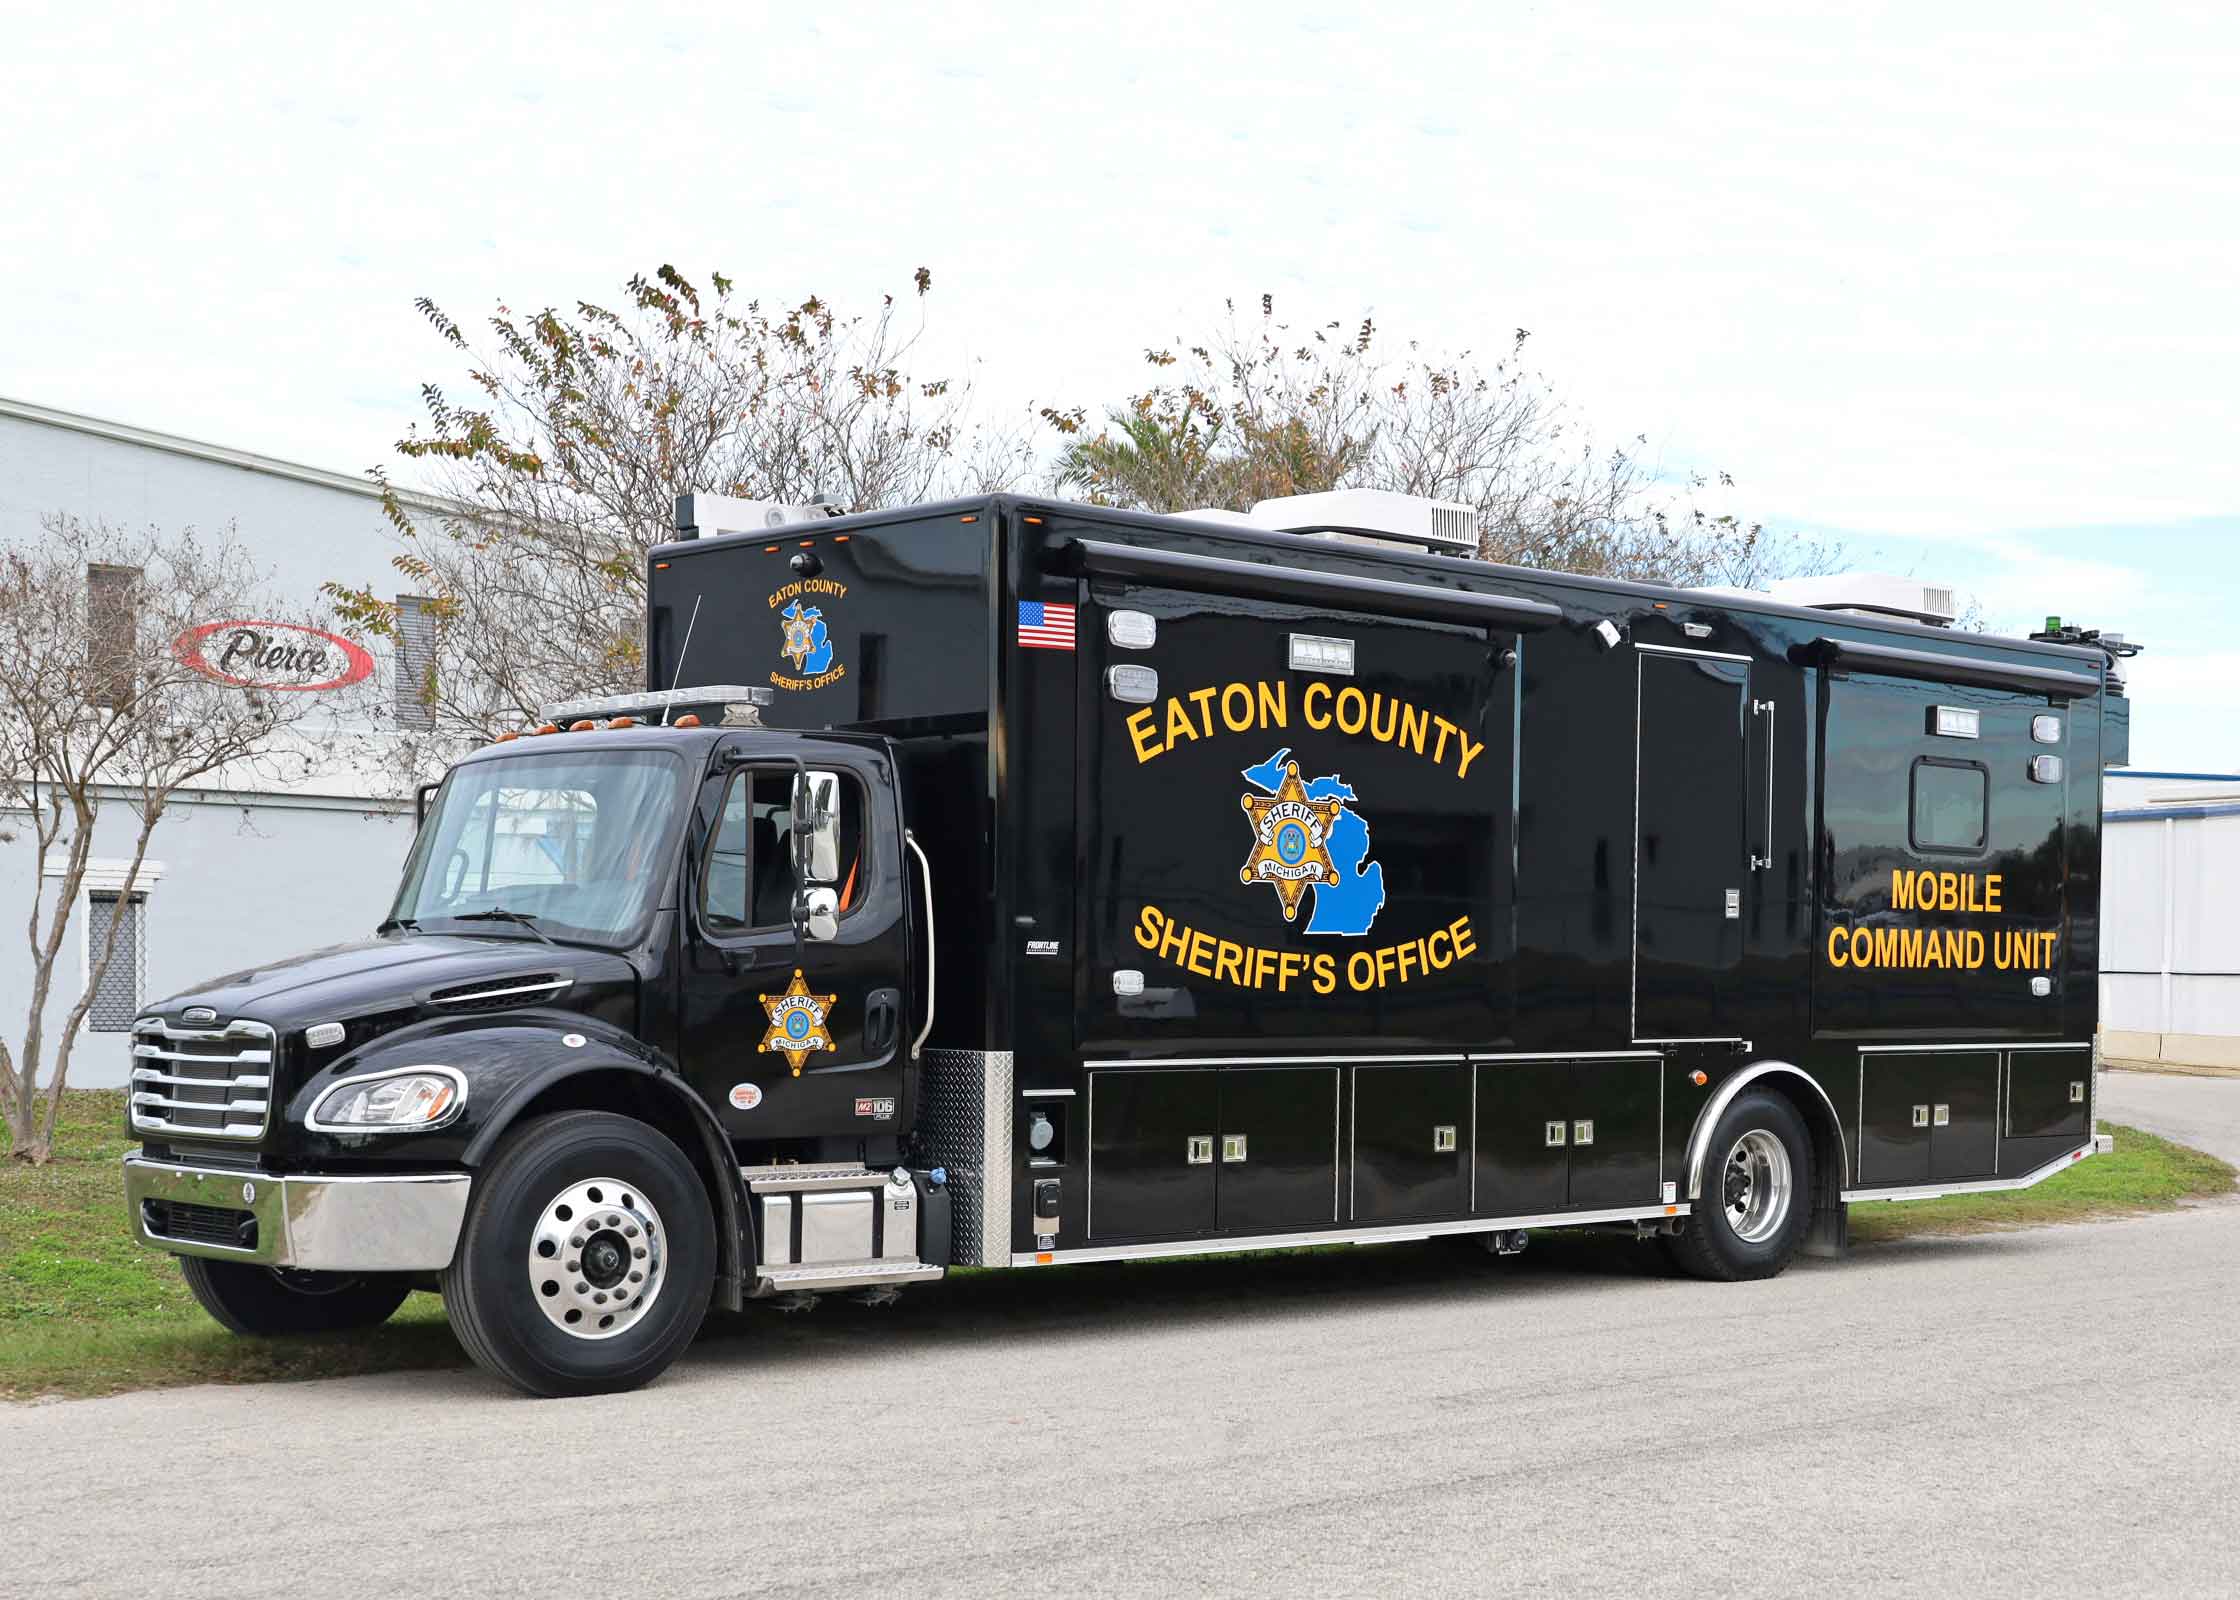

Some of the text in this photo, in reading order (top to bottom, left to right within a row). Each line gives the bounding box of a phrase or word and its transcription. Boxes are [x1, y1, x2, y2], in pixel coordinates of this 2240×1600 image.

[768, 579, 847, 608] EATON COUNTY
[221, 629, 328, 672] Pierce
[770, 664, 845, 690] SHERIFF'S OFFICE
[1126, 681, 1484, 779] EATON COUNTY
[1263, 803, 1321, 830] SHERIFF
[1264, 862, 1317, 877] MICHIGAN
[1891, 869, 2002, 913] MOBILE
[1134, 905, 1477, 994] SHERIFF'S OFFICE
[1828, 926, 2057, 970] COMMAND UNIT
[774, 996, 822, 1016] SHERIFF
[775, 1038, 819, 1049] MICHIGAN
[857, 1100, 893, 1113] M2 106
